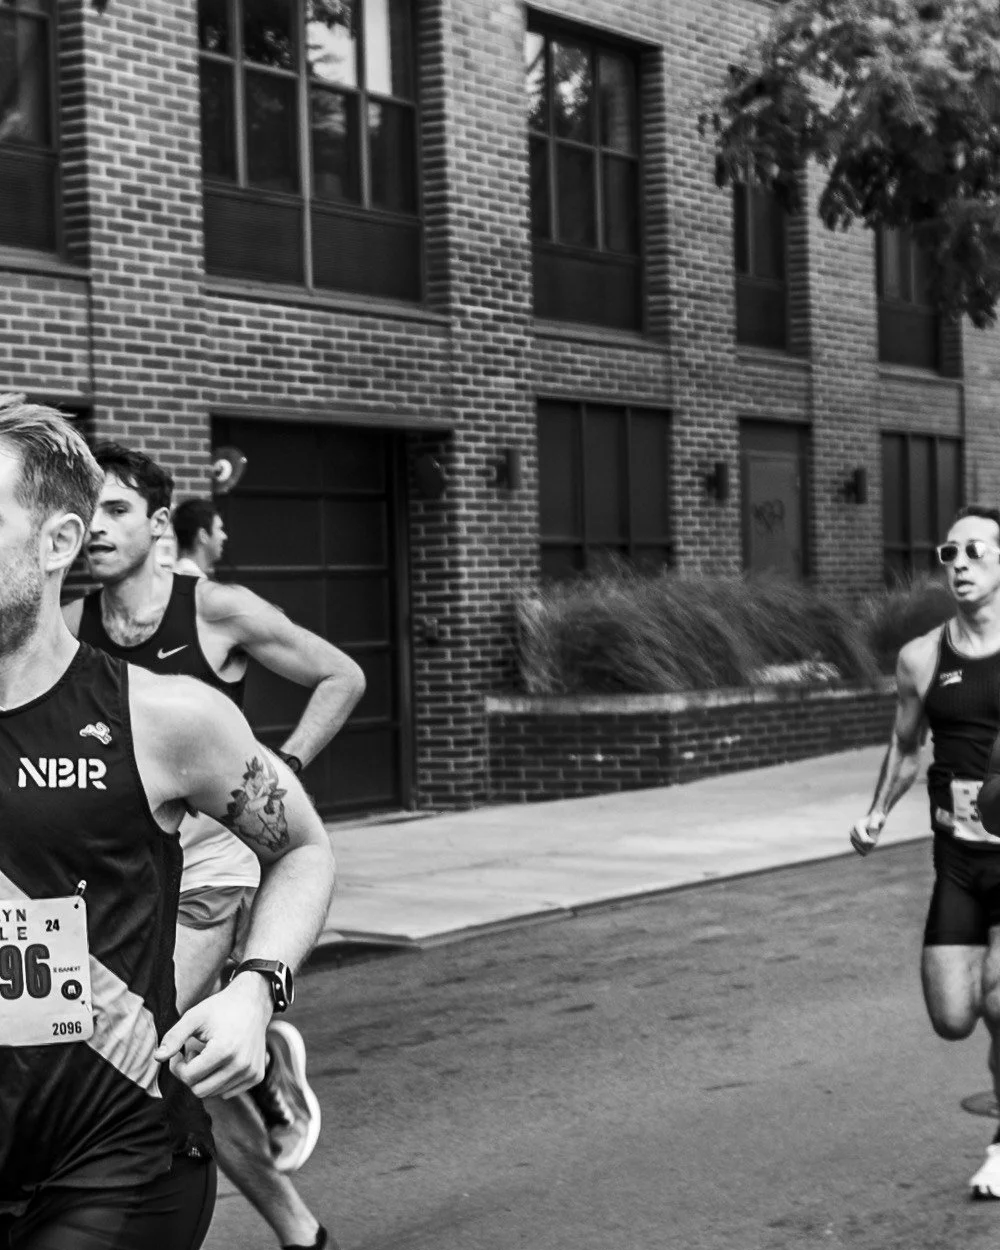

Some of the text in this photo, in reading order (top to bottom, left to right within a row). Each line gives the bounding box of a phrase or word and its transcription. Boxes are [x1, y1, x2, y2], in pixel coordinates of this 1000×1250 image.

[18, 757, 107, 790] NBR
[45, 919, 60, 932] 24
[52, 1021, 82, 1036] 2096
